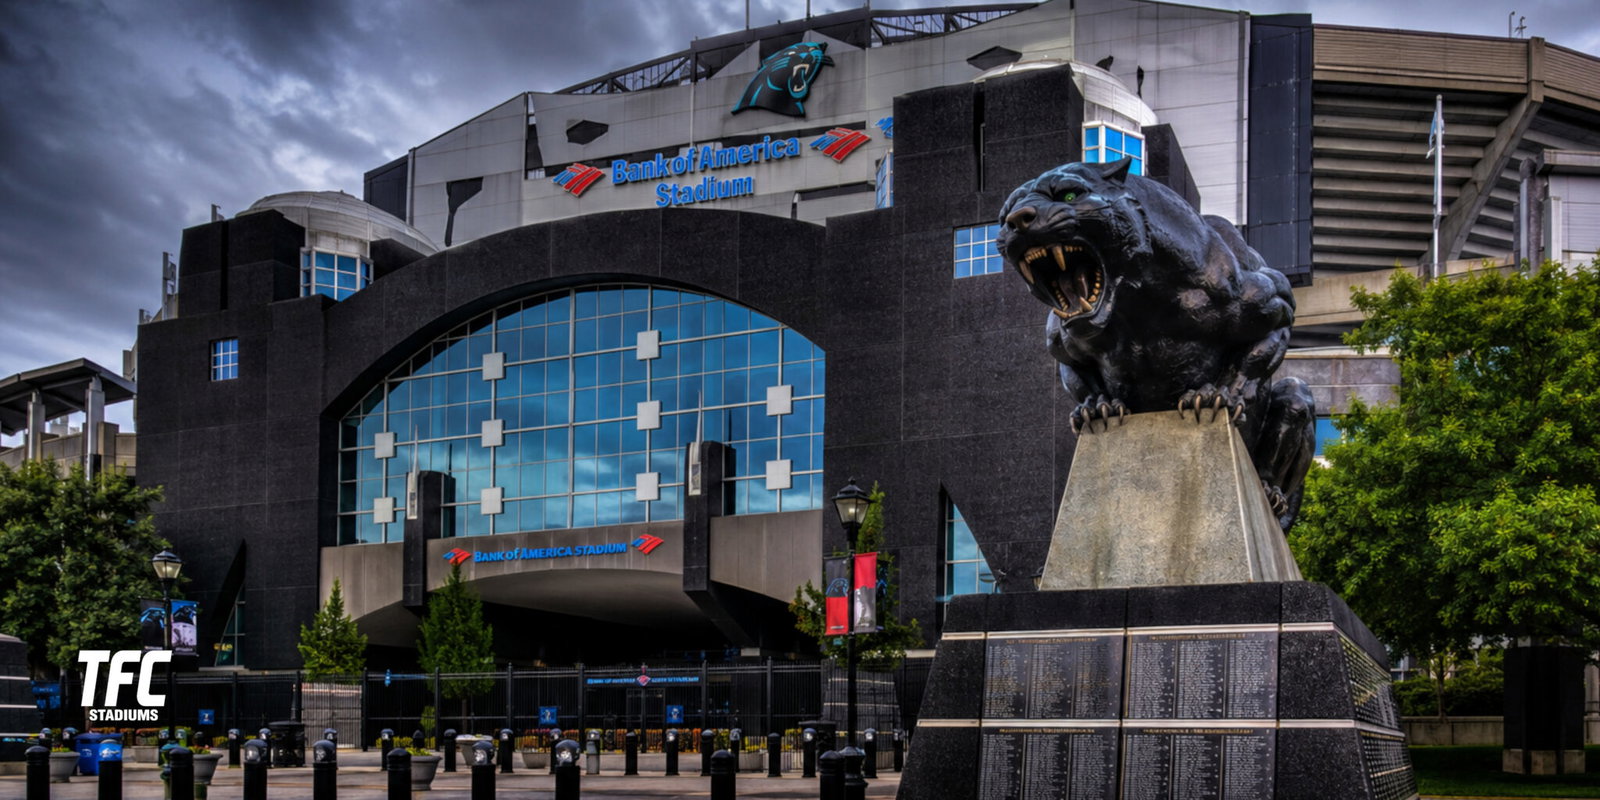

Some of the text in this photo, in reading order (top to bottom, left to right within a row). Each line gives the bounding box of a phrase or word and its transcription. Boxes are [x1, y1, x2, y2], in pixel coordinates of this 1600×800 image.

[612, 135, 800, 185] Bank of America
[655, 176, 754, 207] Stadium
[474, 551, 504, 562] BANK
[520, 546, 573, 560] AMERICA
[574, 543, 626, 556] STADIUM
